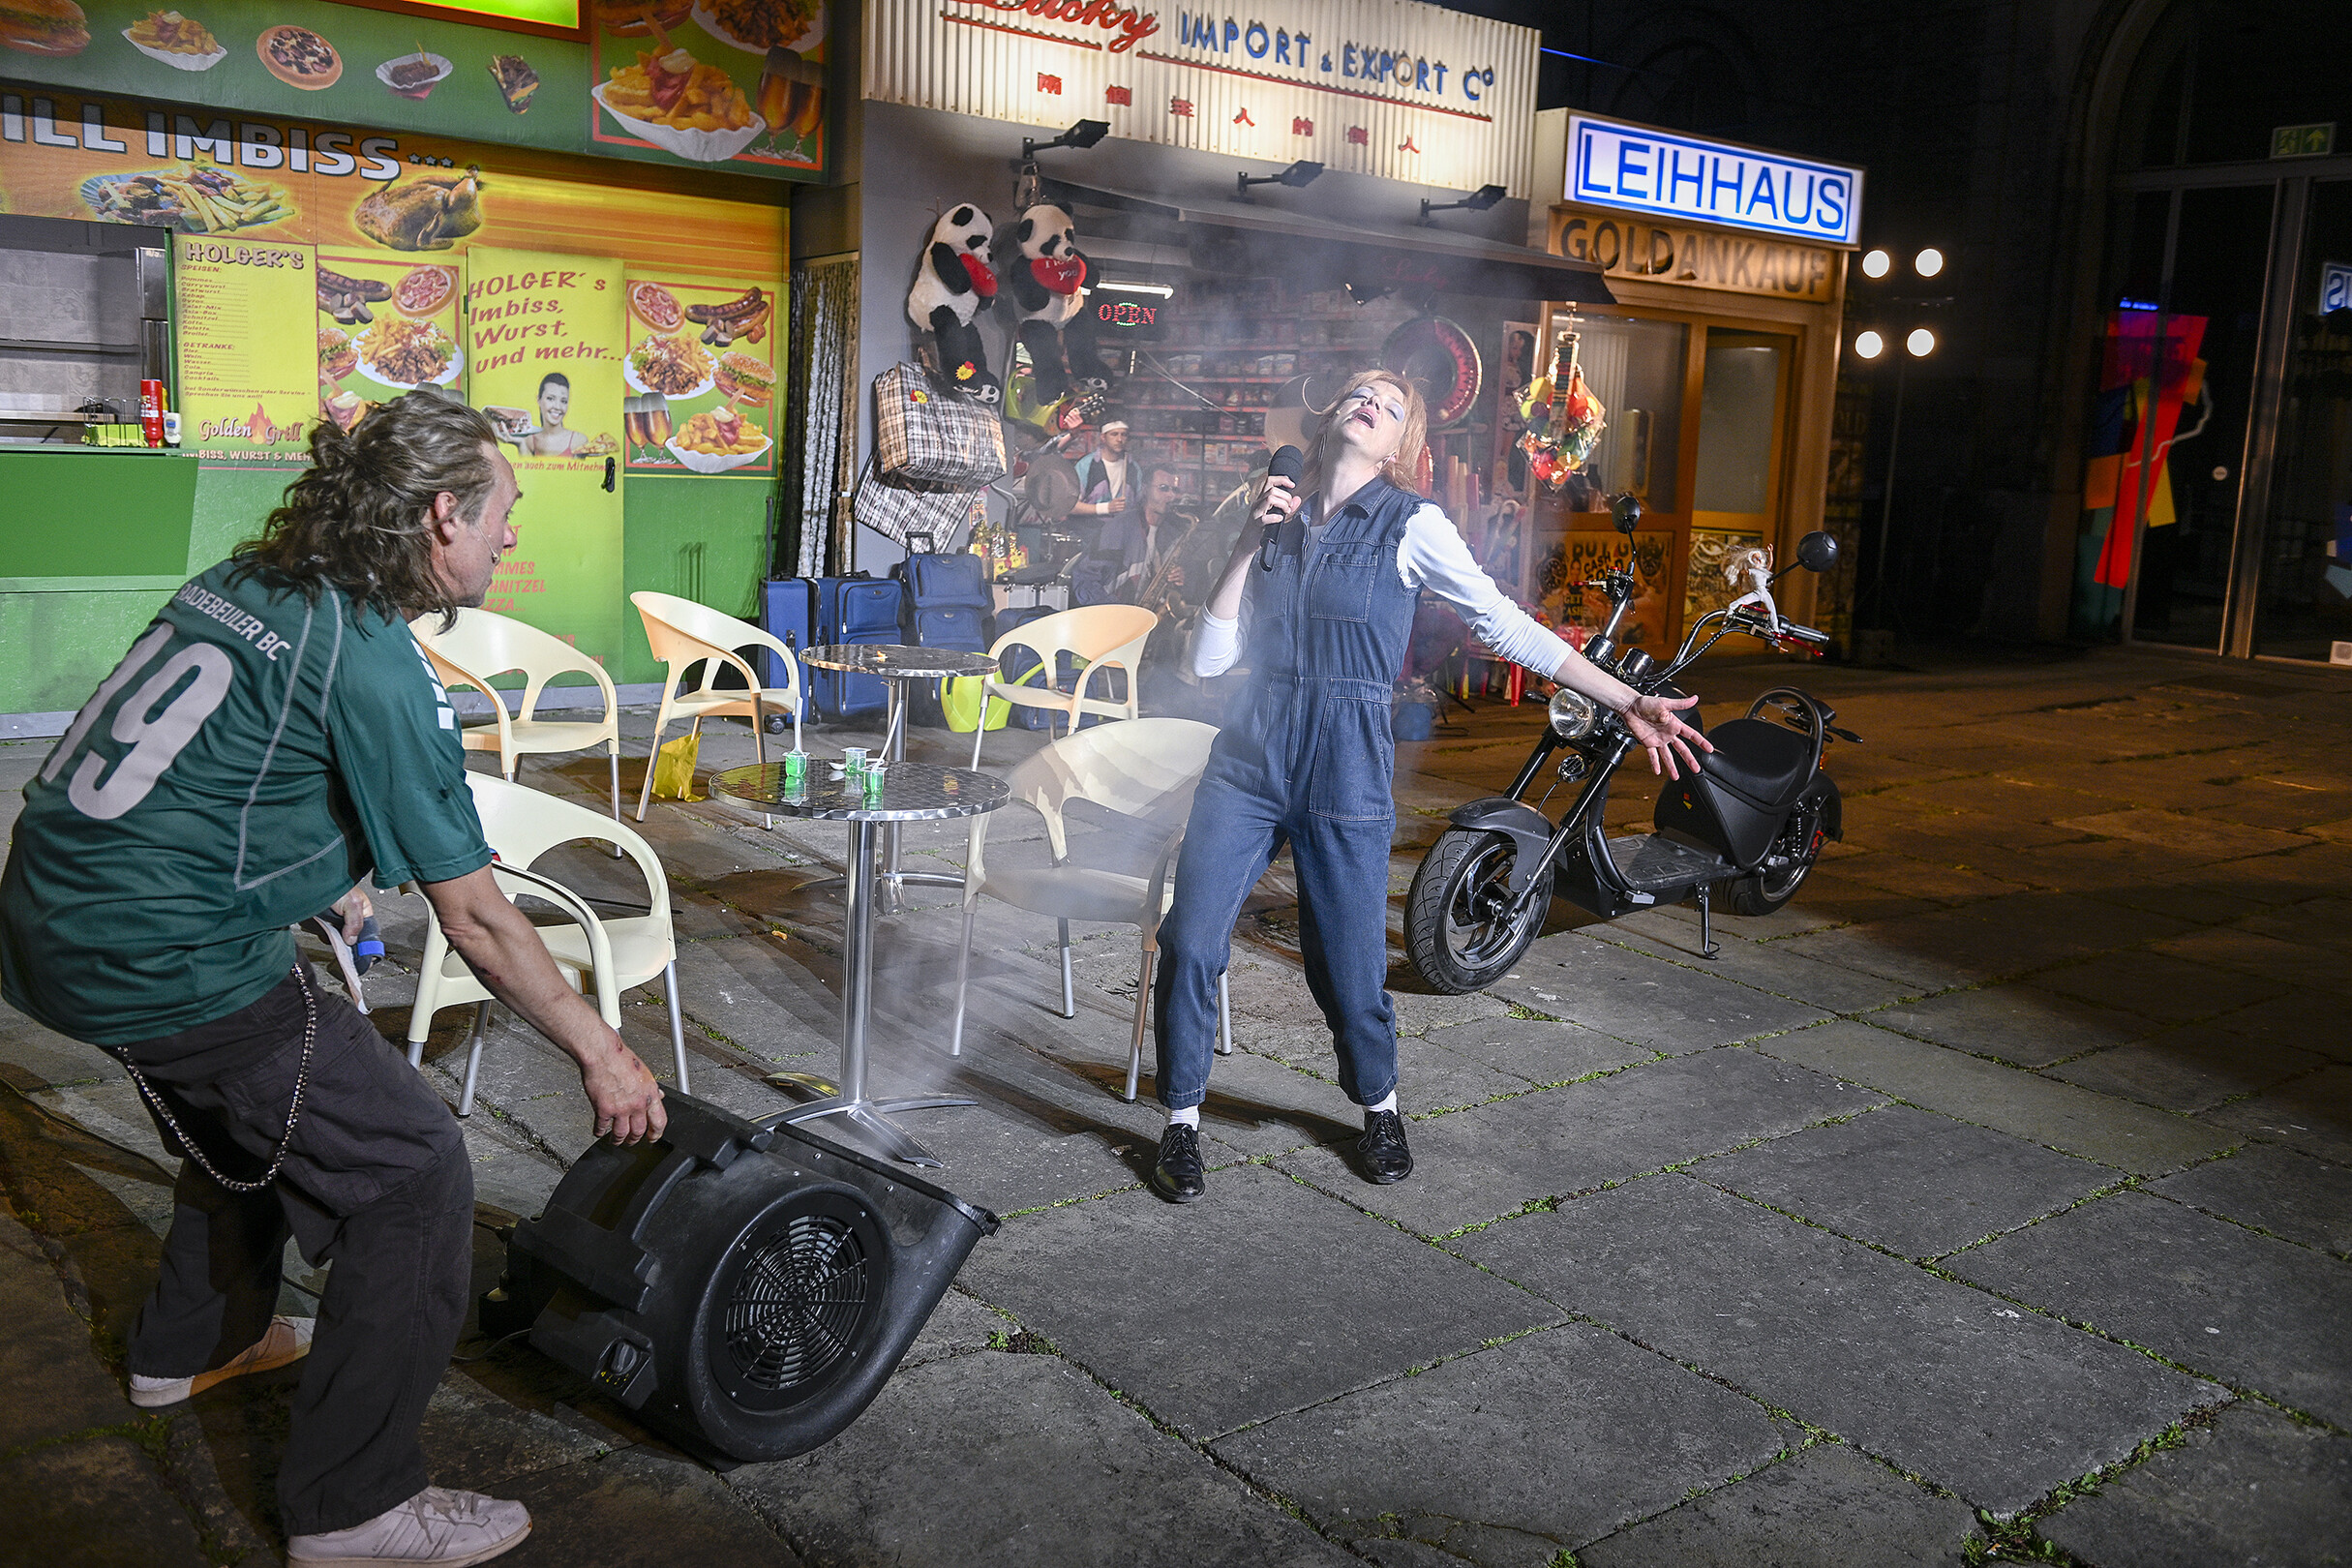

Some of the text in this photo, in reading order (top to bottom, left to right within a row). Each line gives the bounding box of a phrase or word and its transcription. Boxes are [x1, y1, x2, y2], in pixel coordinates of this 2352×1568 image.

[949, 0, 1160, 53] ucky
[1181, 13, 1312, 68] IMPORT
[1321, 51, 1332, 72] &
[1342, 45, 1448, 95] EXPORT
[147, 110, 402, 182] IMBISS
[1583, 134, 1845, 229] LEIHHAUS
[185, 241, 304, 270] HOLGER'S
[1560, 218, 1828, 295] GOLDANKAUF
[468, 297, 564, 326] Imbiss,
[1098, 303, 1158, 325] OPEN
[473, 319, 568, 349] Wurst,
[475, 341, 623, 375] und mehr...
[198, 416, 305, 445] Golden Grill
[229, 449, 271, 461] WURST
[273, 451, 283, 462] &
[546, 463, 565, 471] zum
[1583, 551, 1612, 574] CASH
[175, 583, 292, 661] RADEBEULER BC
[41, 620, 234, 821] 19
